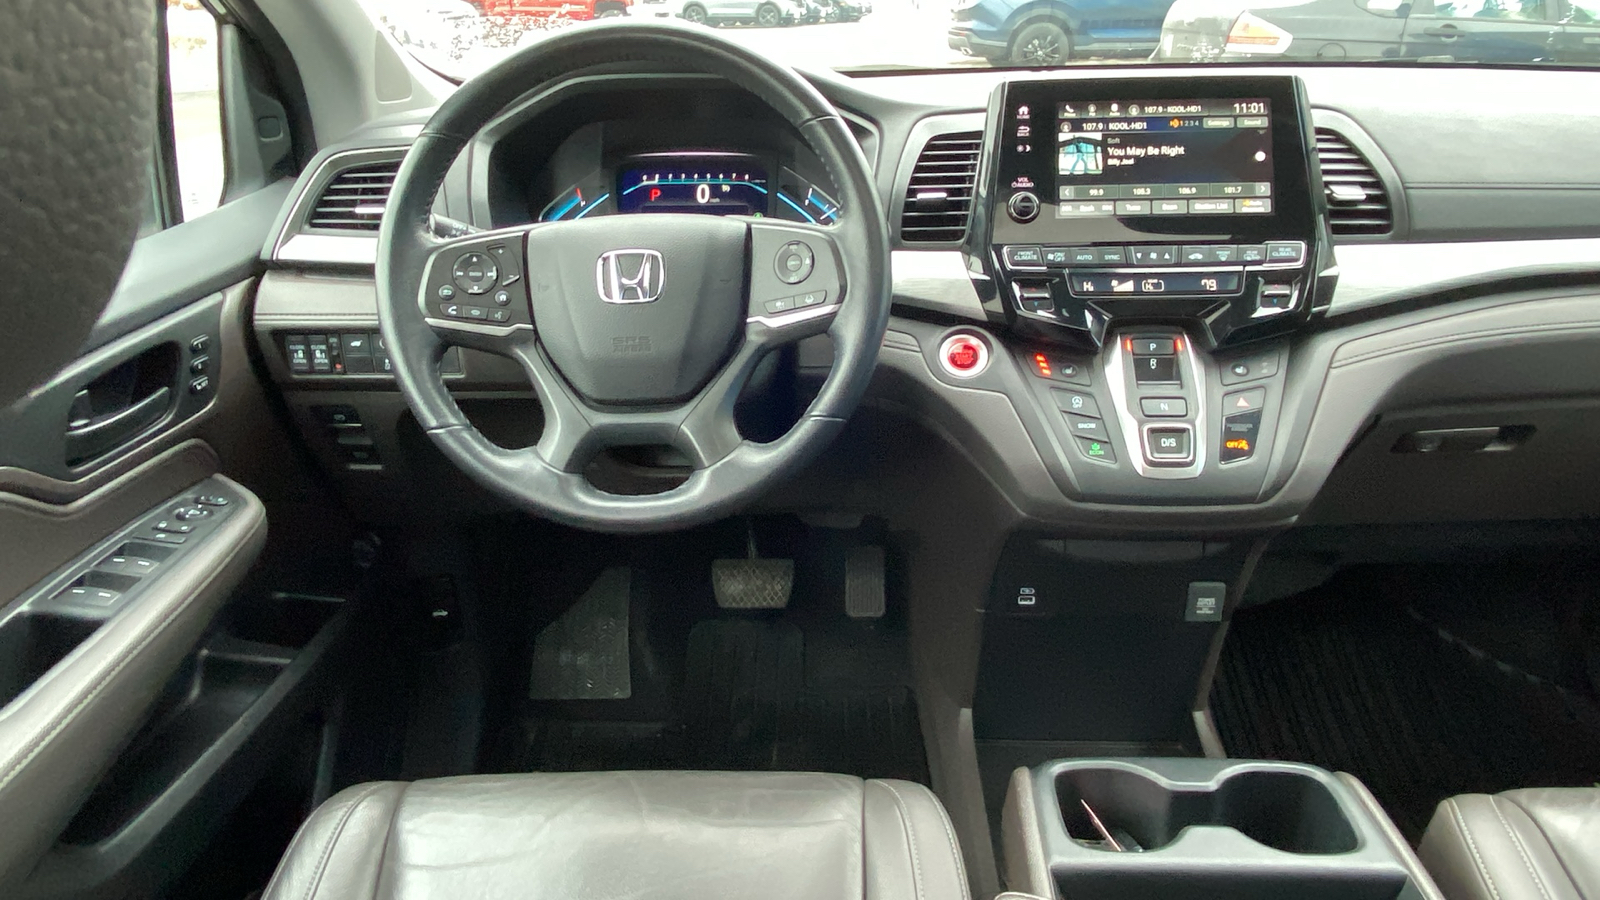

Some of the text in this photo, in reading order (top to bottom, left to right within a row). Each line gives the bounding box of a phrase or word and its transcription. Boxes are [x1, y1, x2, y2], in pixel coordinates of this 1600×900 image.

[1167, 105, 1201, 113] KOOL-HD1
[1233, 103, 1264, 113] 11:01
[1082, 122, 1147, 131] 107.9 KOOL-HD1
[1107, 145, 1185, 158] You May Be Right
[1107, 158, 1120, 166] Billy
[649, 184, 710, 204] P 0
[1201, 279, 1217, 290] 79
[1149, 343, 1156, 351] P
[1160, 438, 1177, 447] D/S
